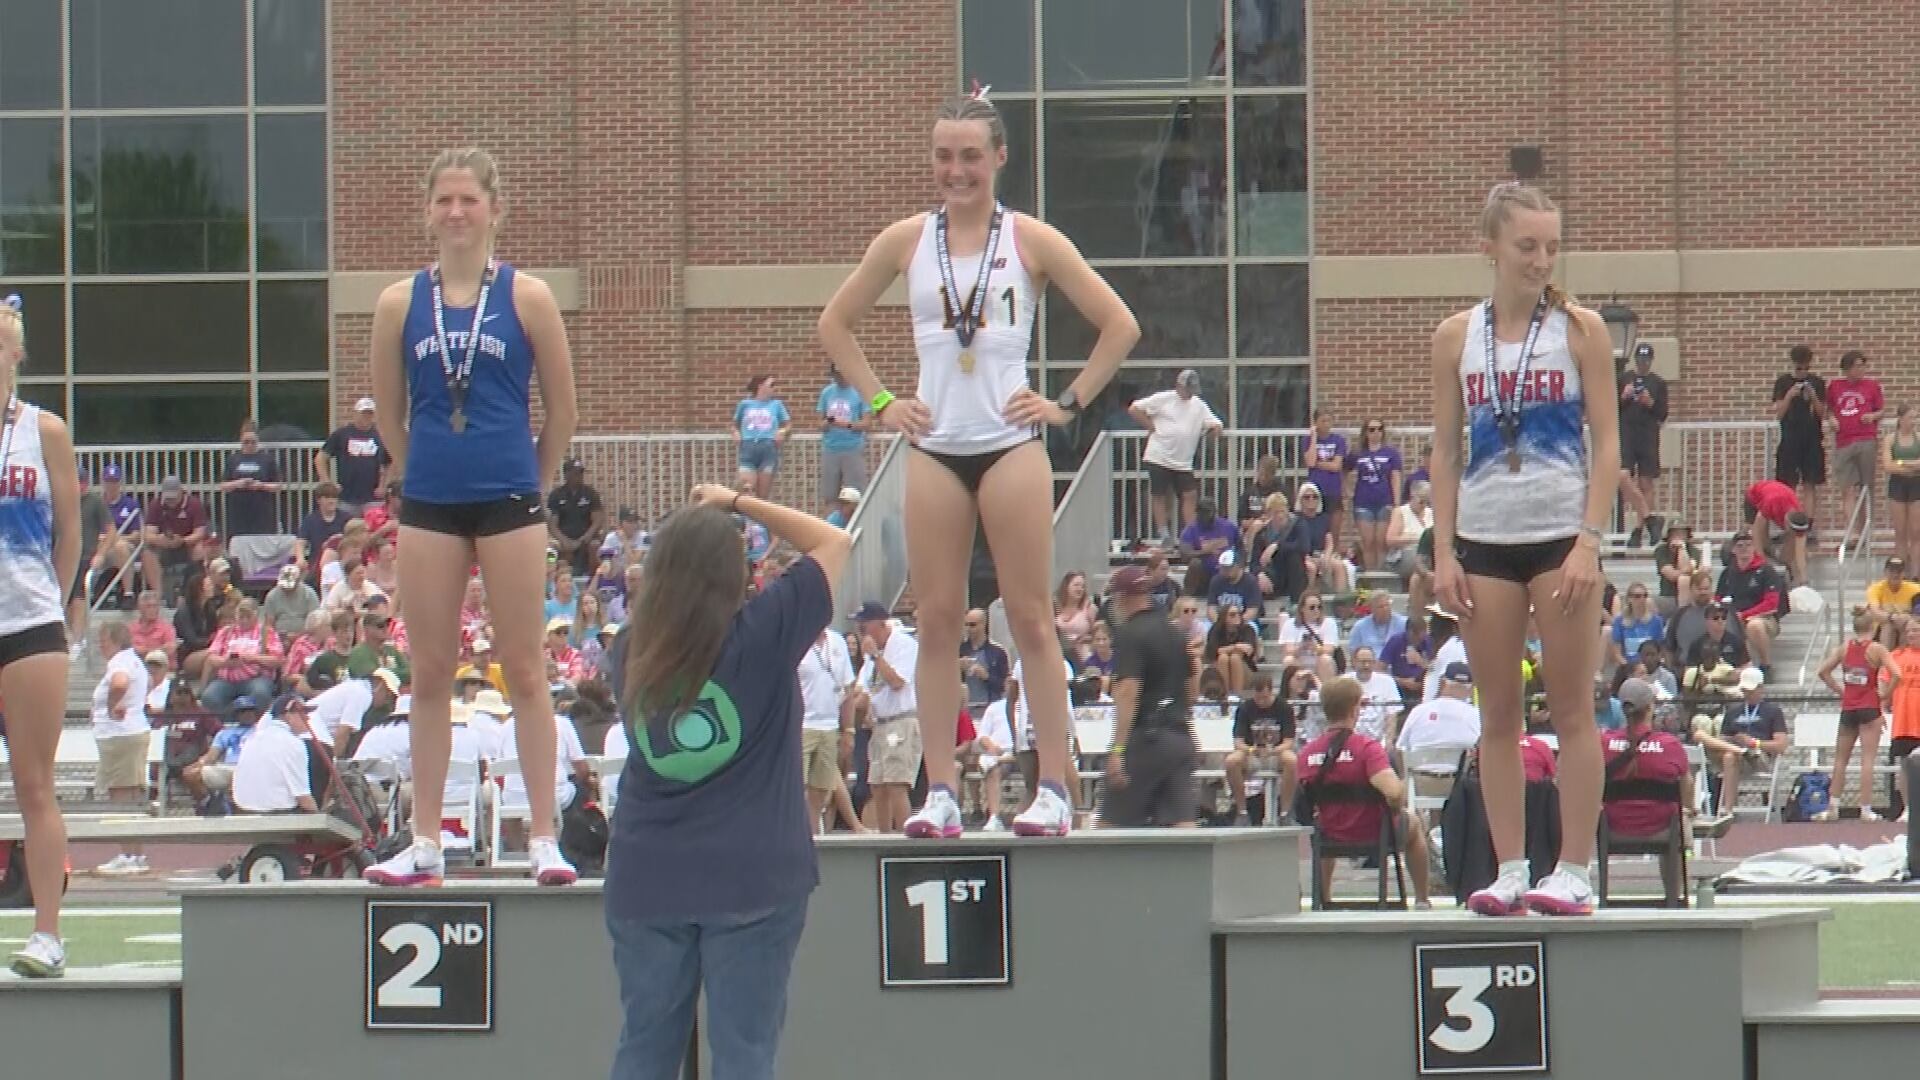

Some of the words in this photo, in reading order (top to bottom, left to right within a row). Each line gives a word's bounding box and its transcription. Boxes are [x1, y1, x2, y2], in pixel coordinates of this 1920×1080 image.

[1001, 285, 1016, 327] 1
[414, 331, 507, 361] WHTEISH
[1466, 369, 1566, 407] SLNGER
[904, 879, 987, 965] 1ST
[378, 922, 484, 1007] 2ND
[1428, 965, 1537, 1053] 3RD
